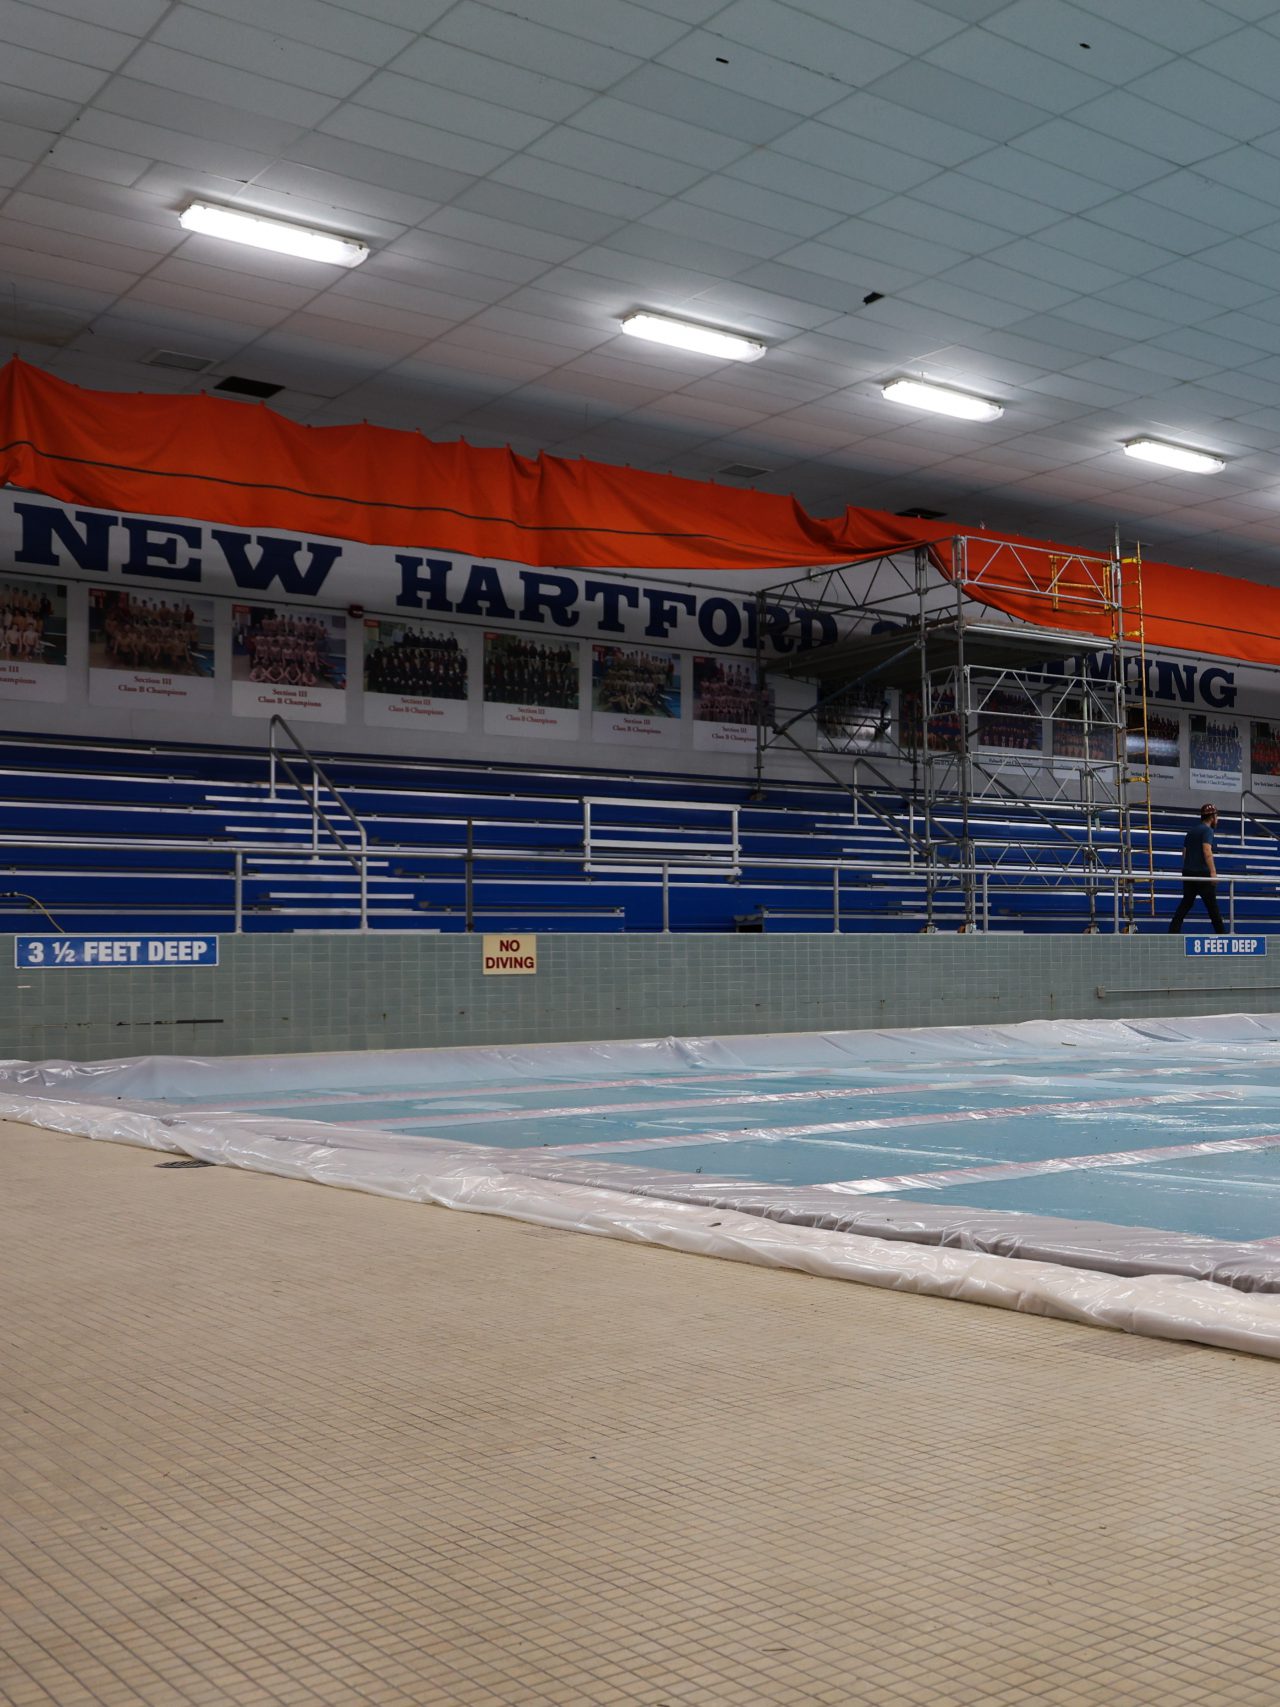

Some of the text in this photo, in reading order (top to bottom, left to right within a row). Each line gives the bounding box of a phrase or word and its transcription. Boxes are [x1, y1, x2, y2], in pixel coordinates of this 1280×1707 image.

[14, 502, 342, 596] NEW
[396, 554, 838, 653] HARTFORD
[146, 687, 187, 696] Champions
[284, 698, 321, 707] Champions
[401, 697, 422, 705] Section
[410, 706, 444, 715] Champions
[28, 941, 207, 963] 3 ½ FEET DEEP
[500, 939, 520, 952] NO
[1194, 939, 1257, 953] 8 FEET DEEP
[485, 956, 534, 969] DIVING
